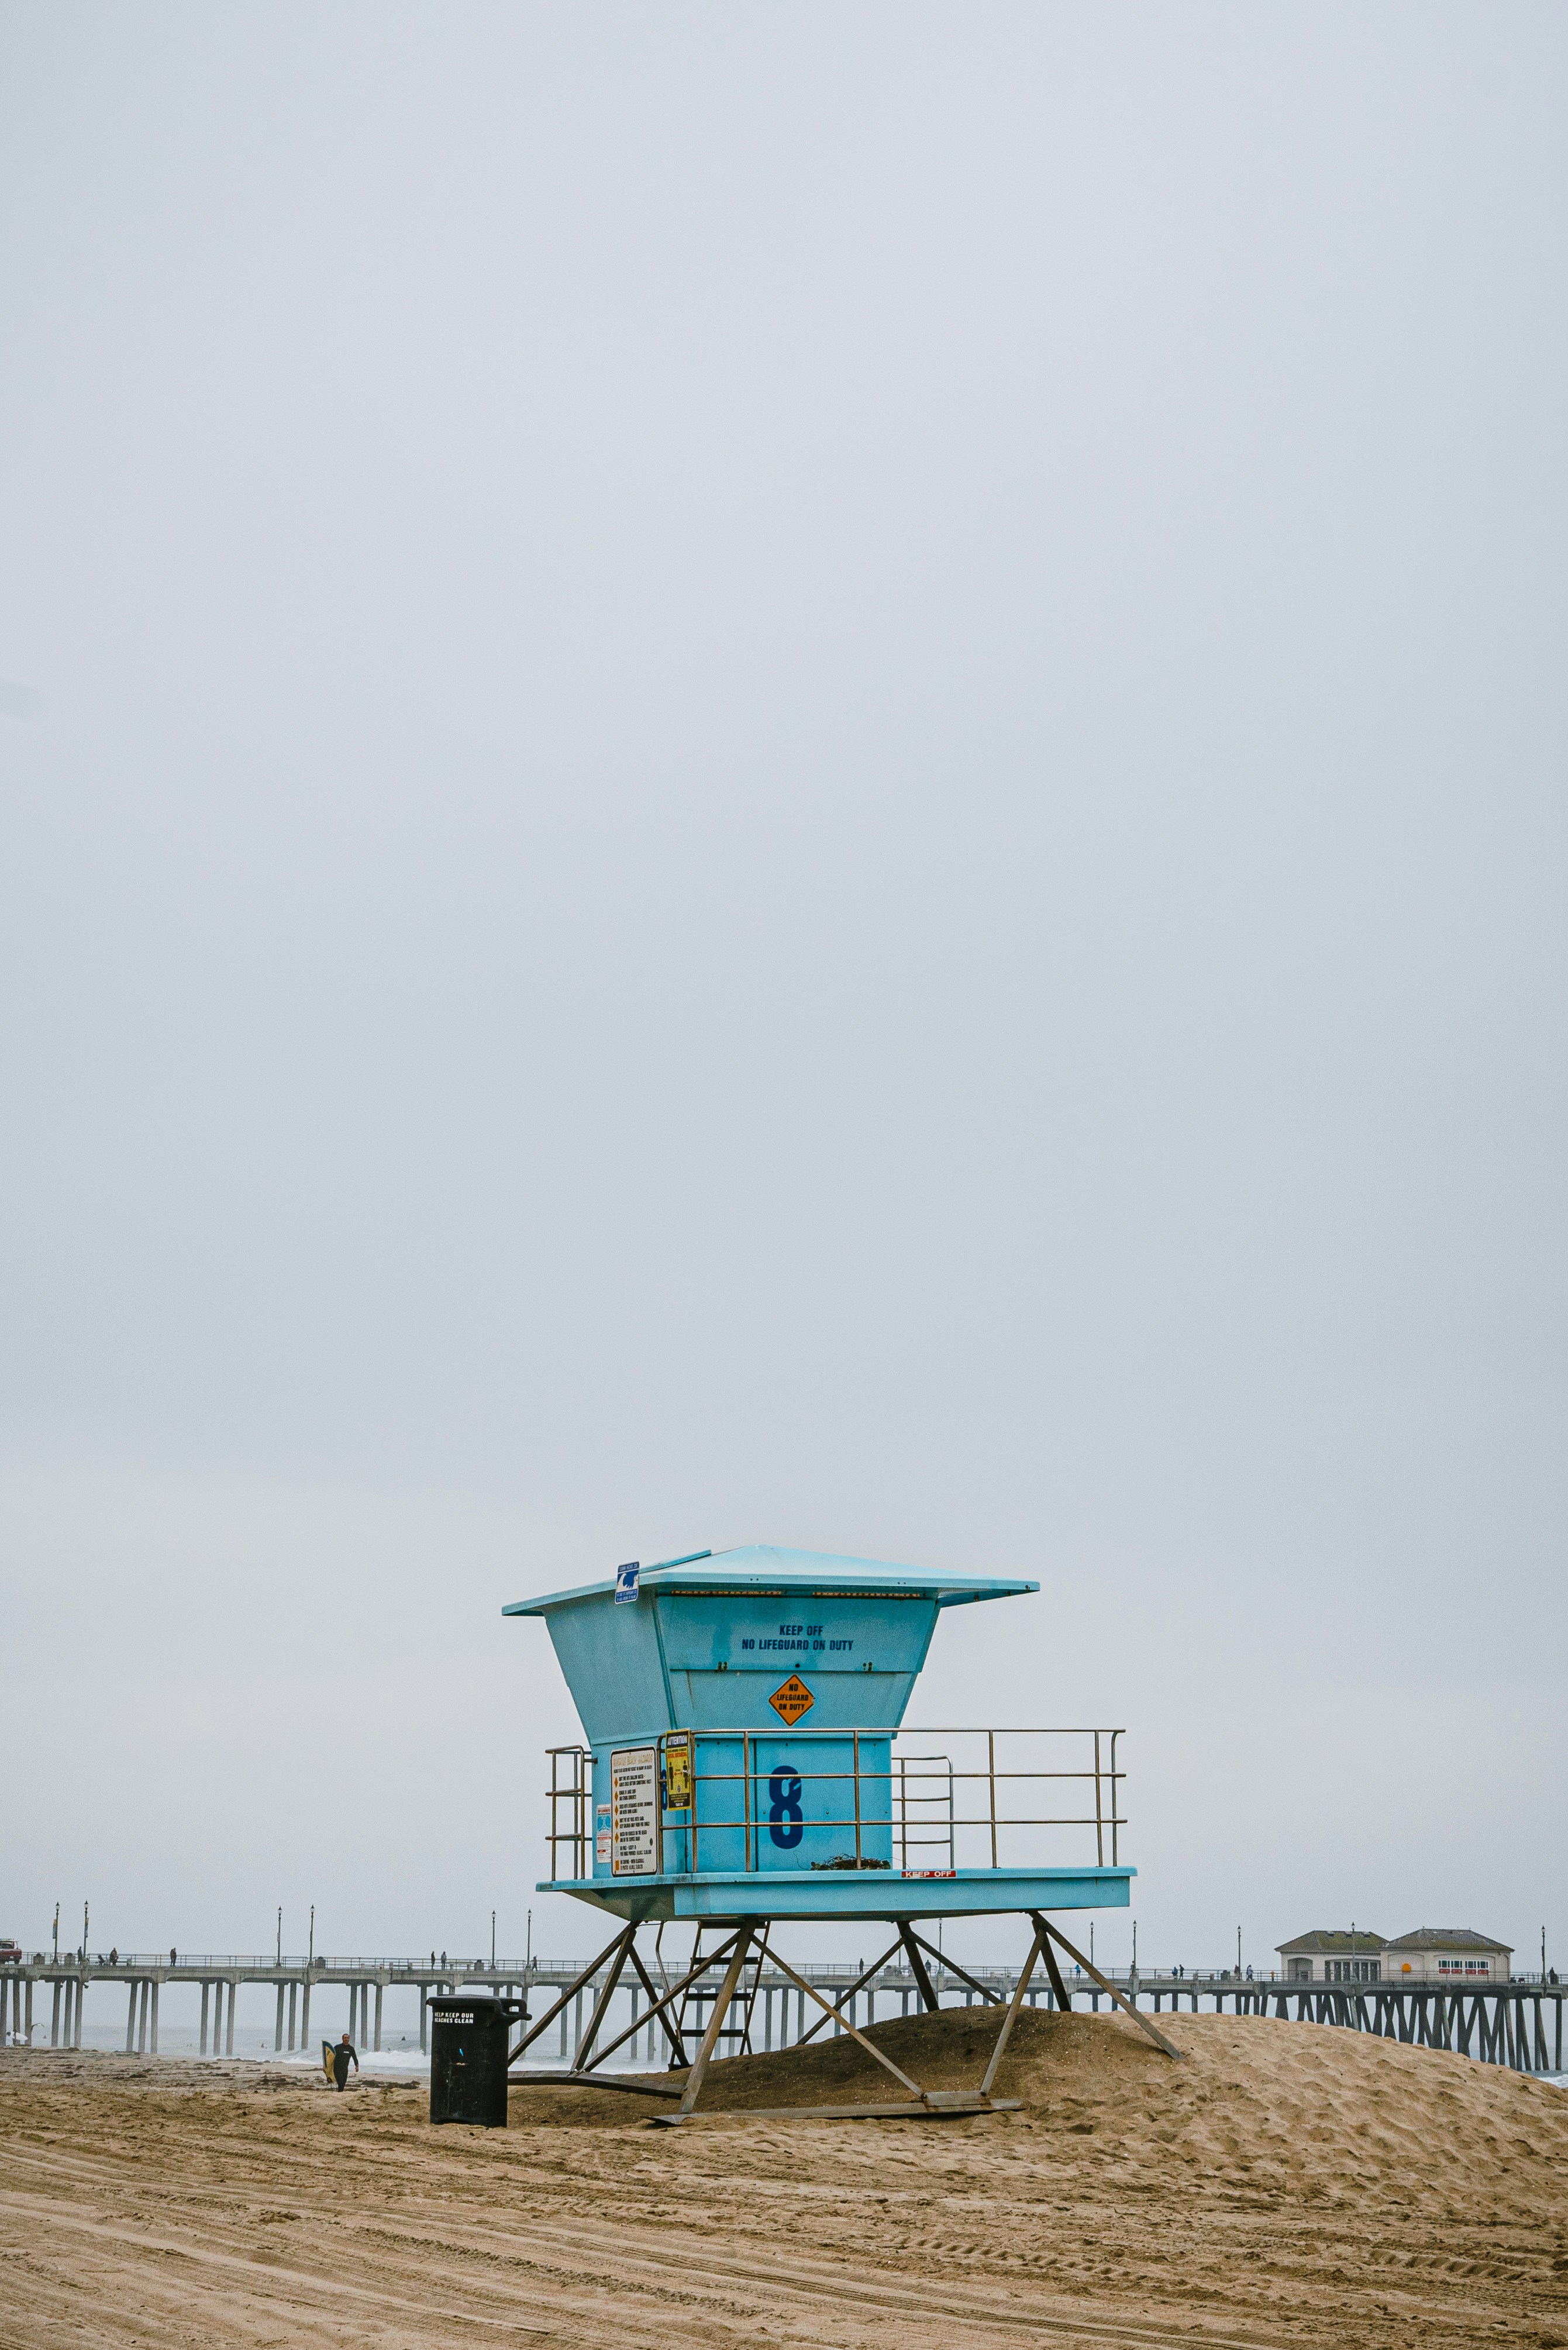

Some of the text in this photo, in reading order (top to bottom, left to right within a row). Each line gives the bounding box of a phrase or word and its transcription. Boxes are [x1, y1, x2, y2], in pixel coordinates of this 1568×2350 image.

[779, 1625, 823, 1636] KEEP OFF
[742, 1639, 854, 1650] NO LIFEGUARD ON DUTY
[769, 1765, 803, 1849] 8
